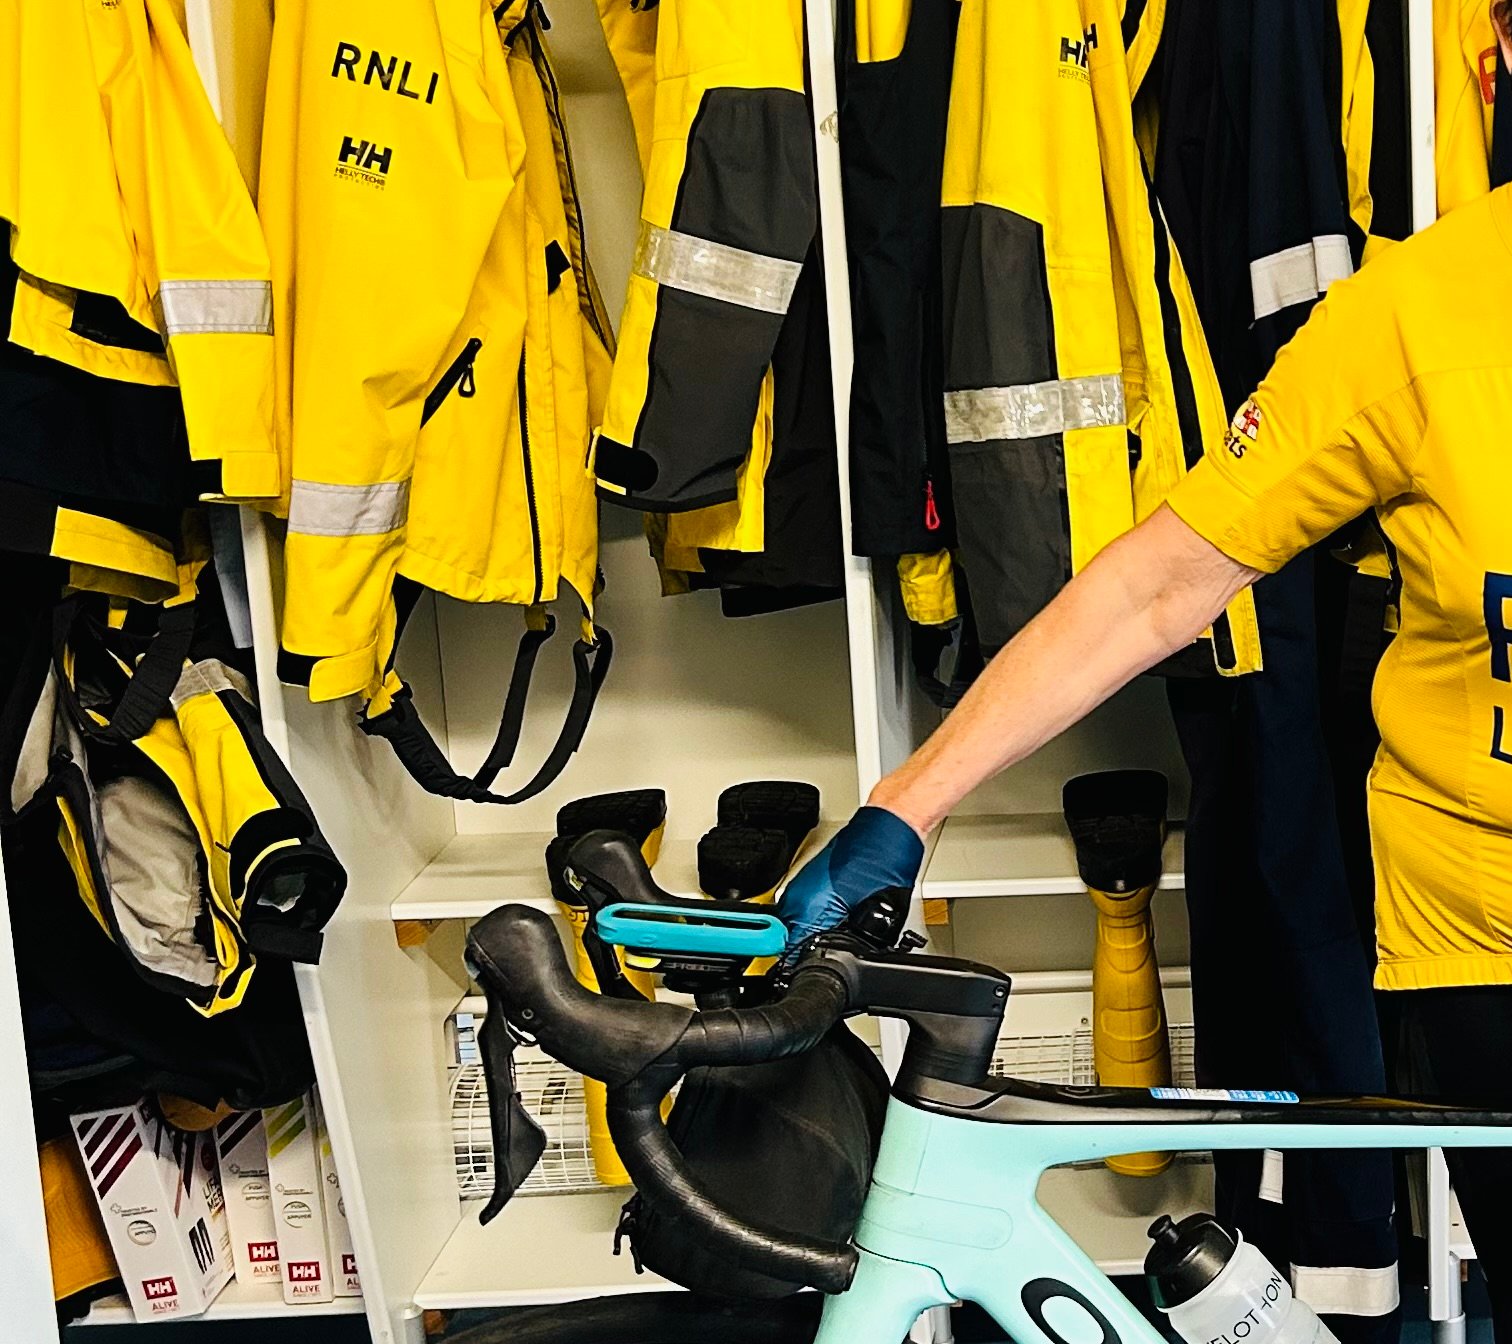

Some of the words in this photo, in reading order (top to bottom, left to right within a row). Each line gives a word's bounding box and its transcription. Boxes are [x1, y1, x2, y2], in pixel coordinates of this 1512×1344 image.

[332, 41, 439, 105] RNLI
[338, 136, 392, 174] HH
[293, 1285, 320, 1294] ALIVE
[152, 1299, 179, 1312] ALIVE
